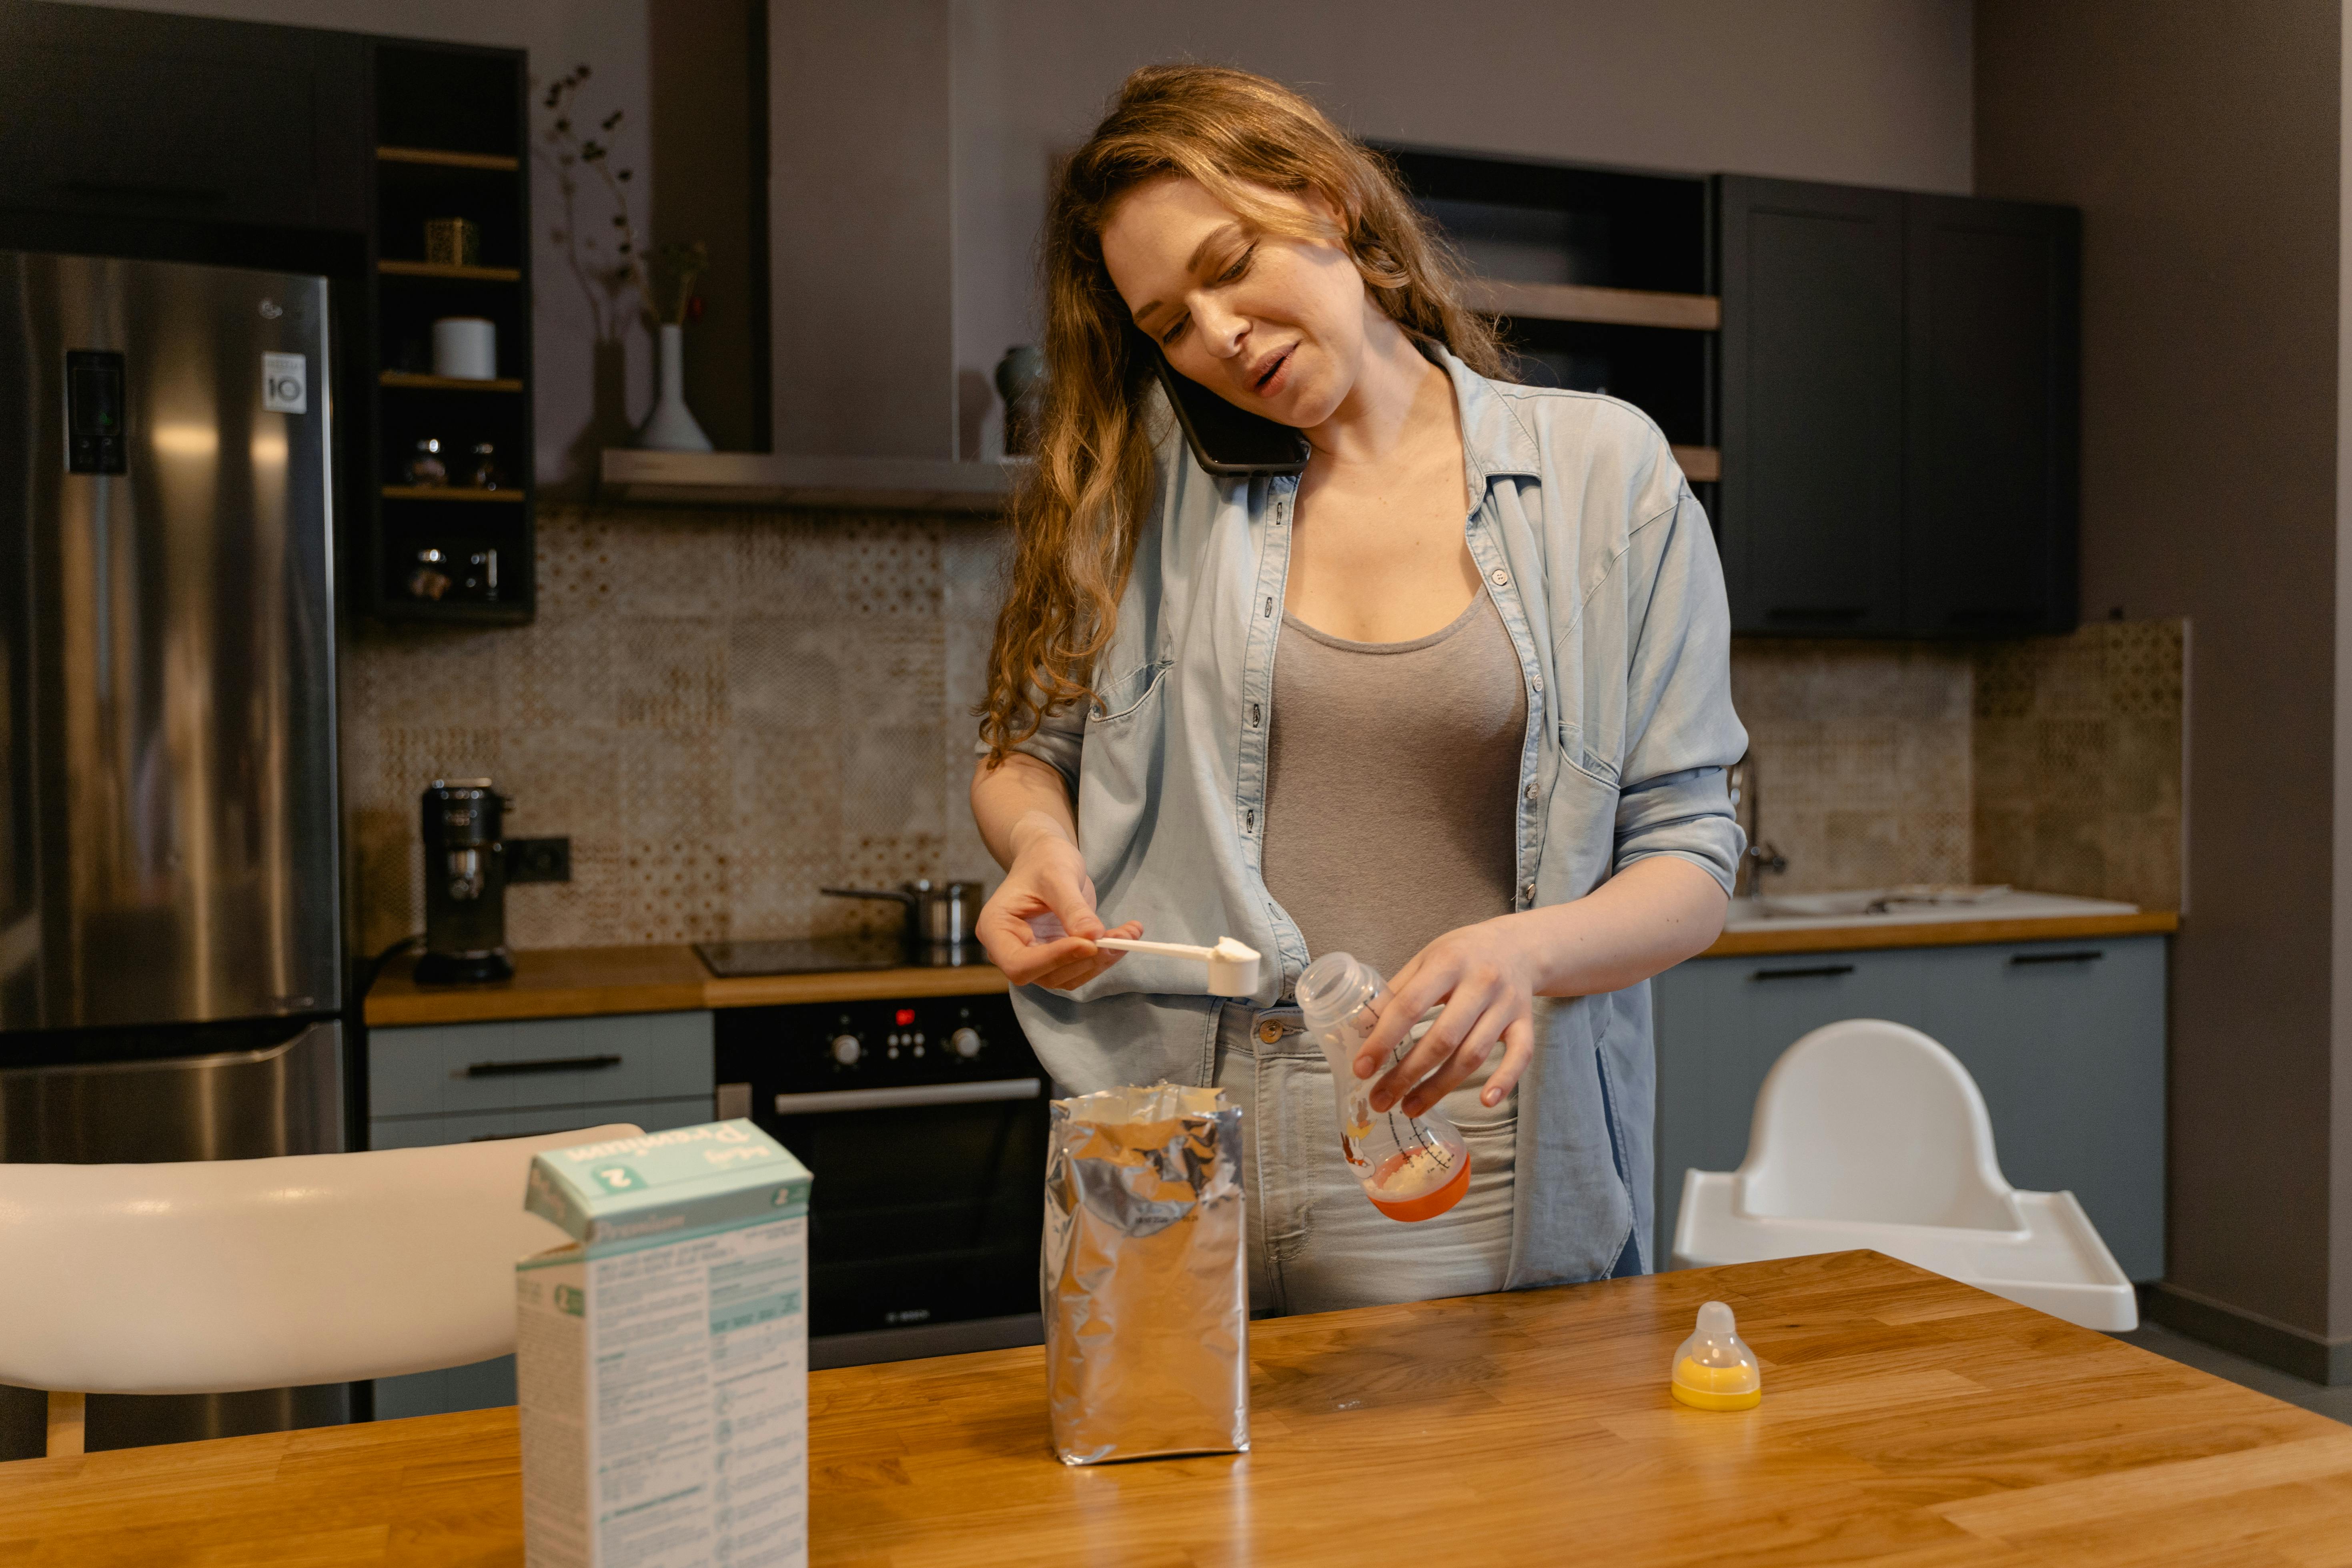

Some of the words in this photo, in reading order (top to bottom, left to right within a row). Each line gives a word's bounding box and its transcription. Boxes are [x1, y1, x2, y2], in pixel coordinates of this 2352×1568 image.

[268, 376, 301, 403] 10
[565, 1124, 751, 1161] Premium
[601, 1168, 632, 1188] 2
